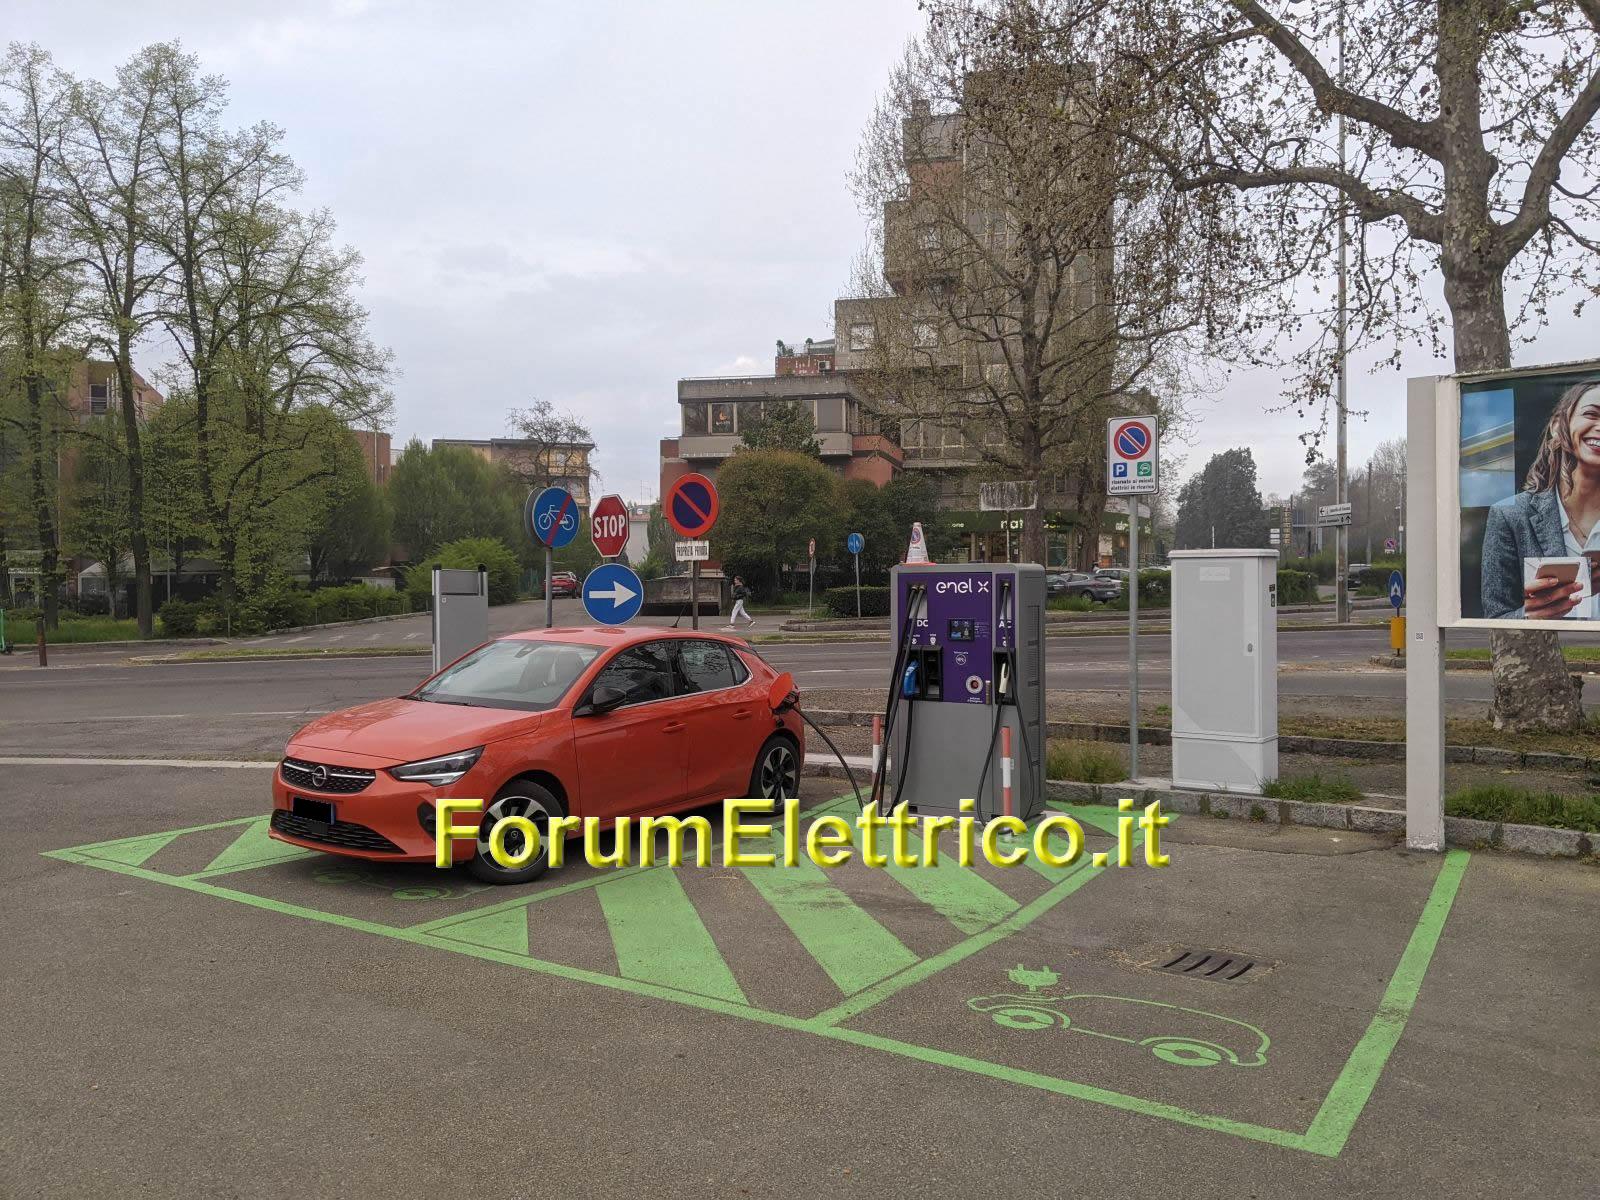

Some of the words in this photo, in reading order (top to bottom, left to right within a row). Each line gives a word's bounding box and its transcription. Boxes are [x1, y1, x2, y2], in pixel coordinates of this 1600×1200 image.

[1115, 464, 1125, 476] P
[594, 514, 626, 538] STOP
[936, 578, 973, 594] enel
[916, 619, 929, 627] DC
[998, 620, 1013, 629] AC
